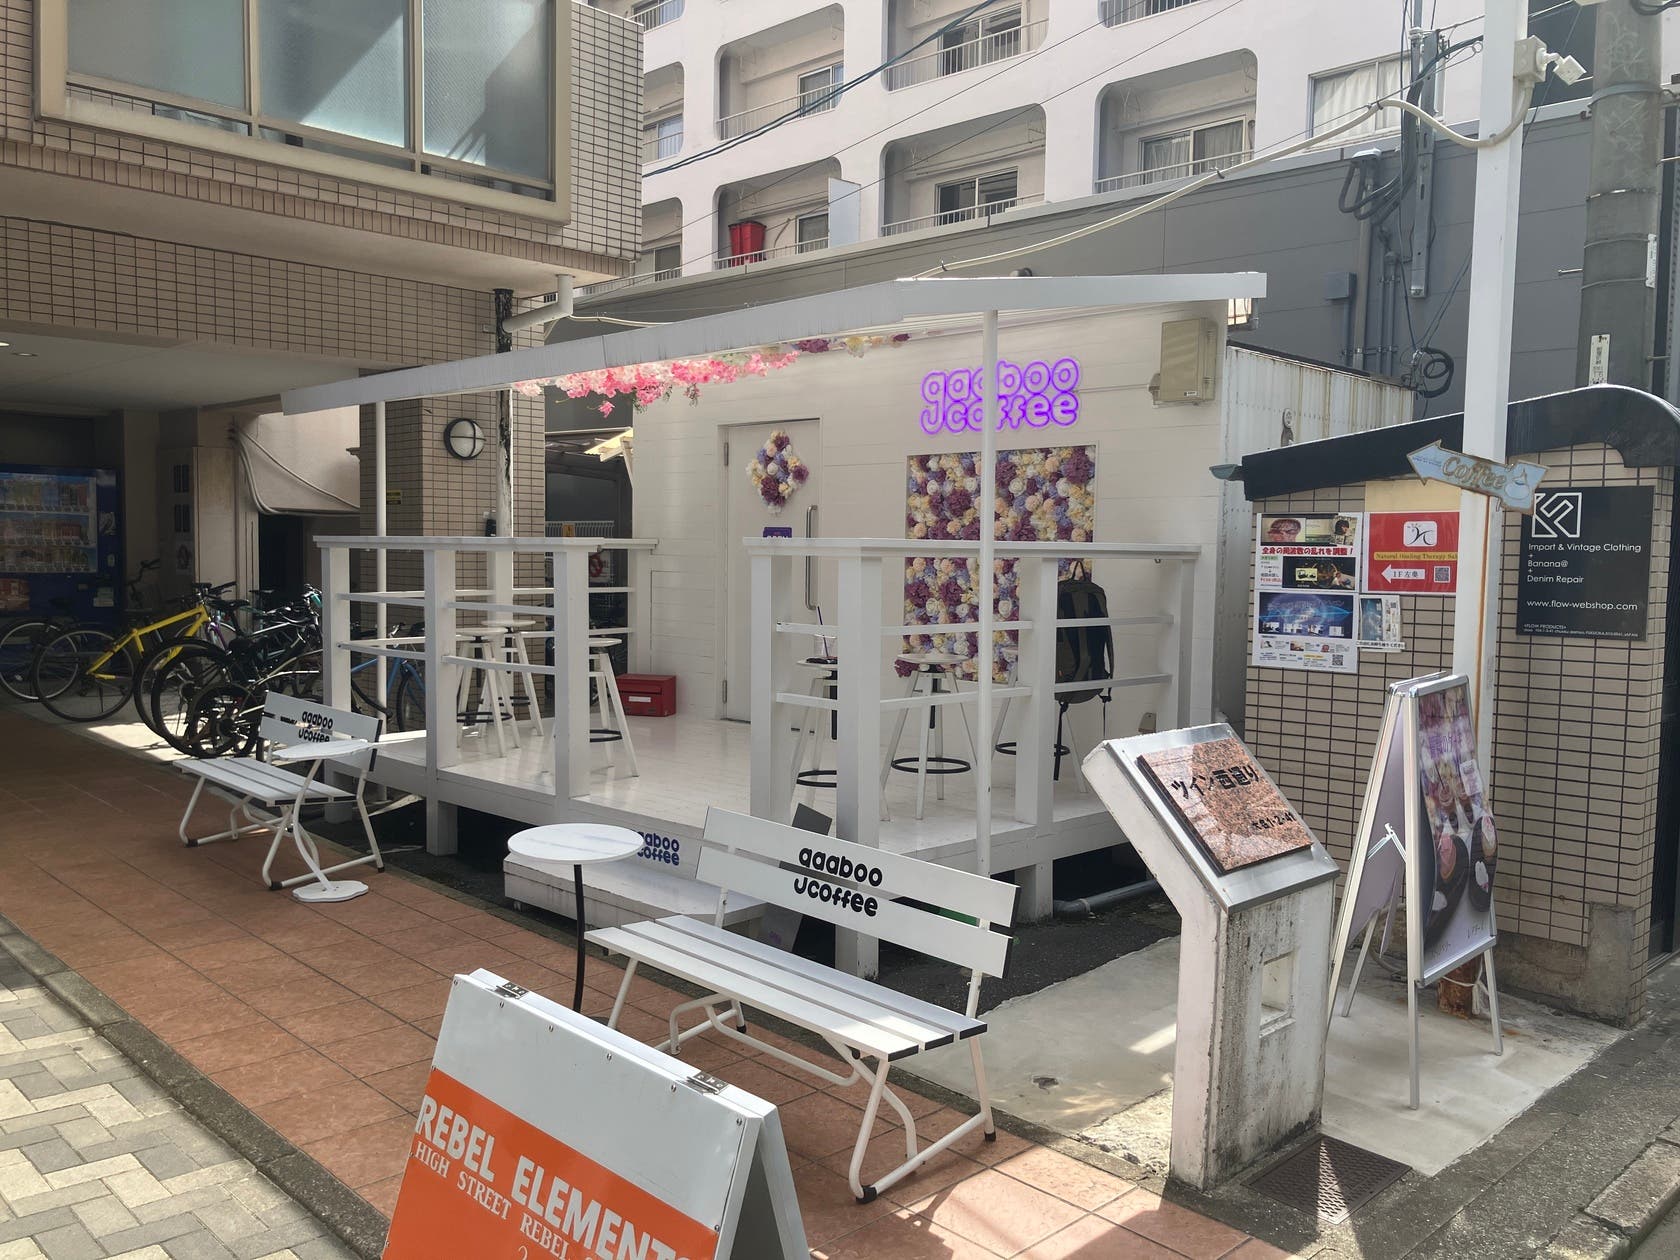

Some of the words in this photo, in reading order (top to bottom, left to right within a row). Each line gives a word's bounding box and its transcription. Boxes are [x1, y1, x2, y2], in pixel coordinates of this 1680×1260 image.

[1441, 456, 1507, 489] Coffee
[1528, 543, 1556, 551] Import
[1558, 543, 1565, 551] &
[1567, 543, 1602, 553] Vintage
[1603, 544, 1642, 553] Clothing
[1422, 553, 1446, 561] Therapy
[1527, 560, 1569, 568] Banana@
[1527, 575, 1554, 583] Denim
[1556, 575, 1585, 584] Repair
[1526, 599, 1638, 611] www.flow-webshop.com
[1170, 765, 1260, 800] ツイン西通り
[415, 1094, 496, 1182] REBEL
[415, 1141, 451, 1179] HIGH
[456, 1171, 512, 1221] STREET
